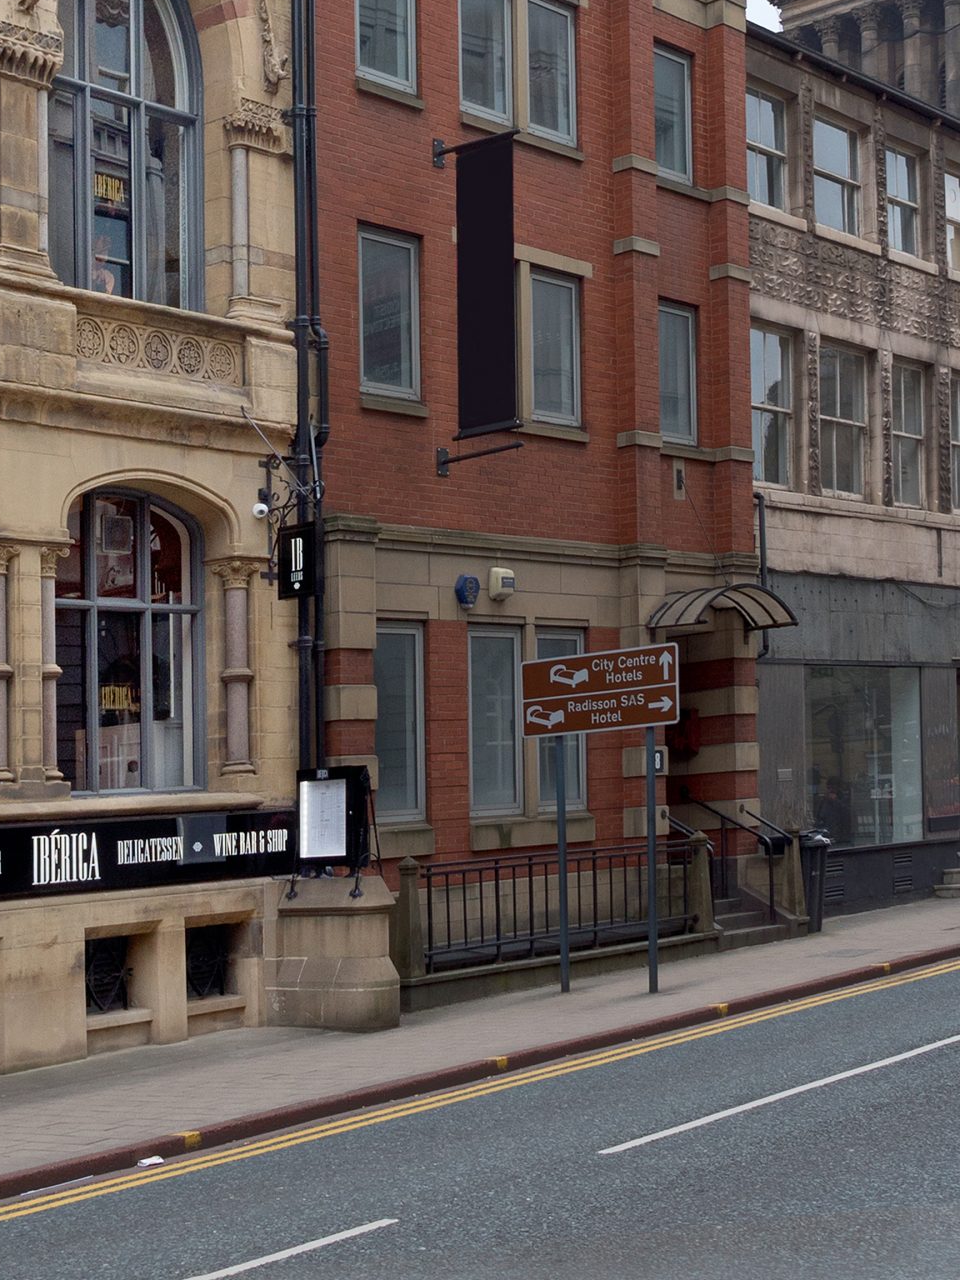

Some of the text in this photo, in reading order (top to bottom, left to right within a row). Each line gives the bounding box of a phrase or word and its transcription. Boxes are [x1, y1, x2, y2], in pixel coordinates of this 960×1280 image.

[290, 537, 303, 571] IB
[591, 654, 656, 672] City Centre
[606, 670, 643, 684] Hotels
[567, 693, 645, 712] Radisson SAS
[591, 710, 622, 724] Hotel
[31, 829, 101, 886] IBÉRICA
[117, 836, 184, 865] DELICATESSEN
[213, 832, 238, 857] WINE
[239, 830, 257, 855] BAR
[259, 830, 265, 853] &
[267, 829, 288, 852] SHOP
